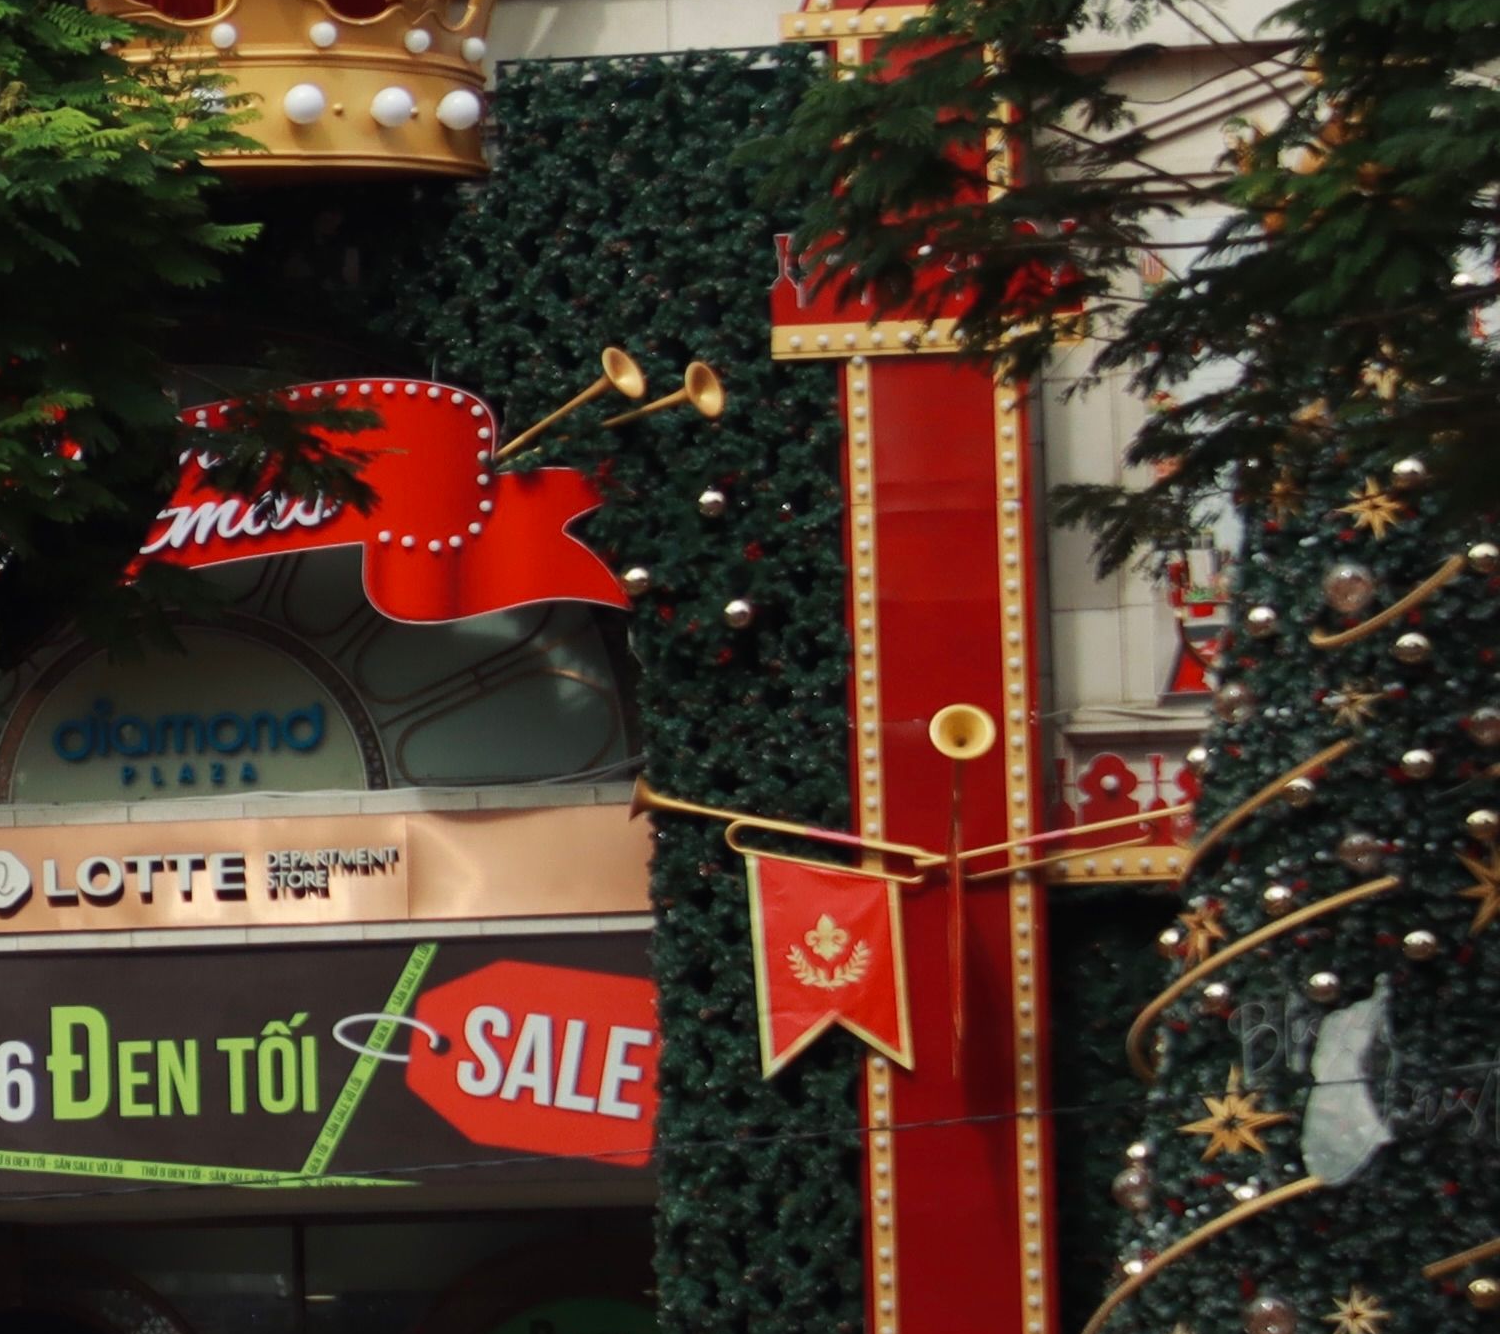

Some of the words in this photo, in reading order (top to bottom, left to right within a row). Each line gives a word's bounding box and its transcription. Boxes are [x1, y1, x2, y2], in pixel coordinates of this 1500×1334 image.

[54, 698, 326, 762] diamond
[121, 762, 257, 786] PLAZA
[43, 852, 247, 899] LOTTE
[267, 847, 398, 867] DEPARTMENT
[267, 870, 328, 889] STORE
[46, 1005, 200, 1121] ĐEN
[216, 1012, 319, 1115] TỐI
[456, 1004, 653, 1121] SALE
